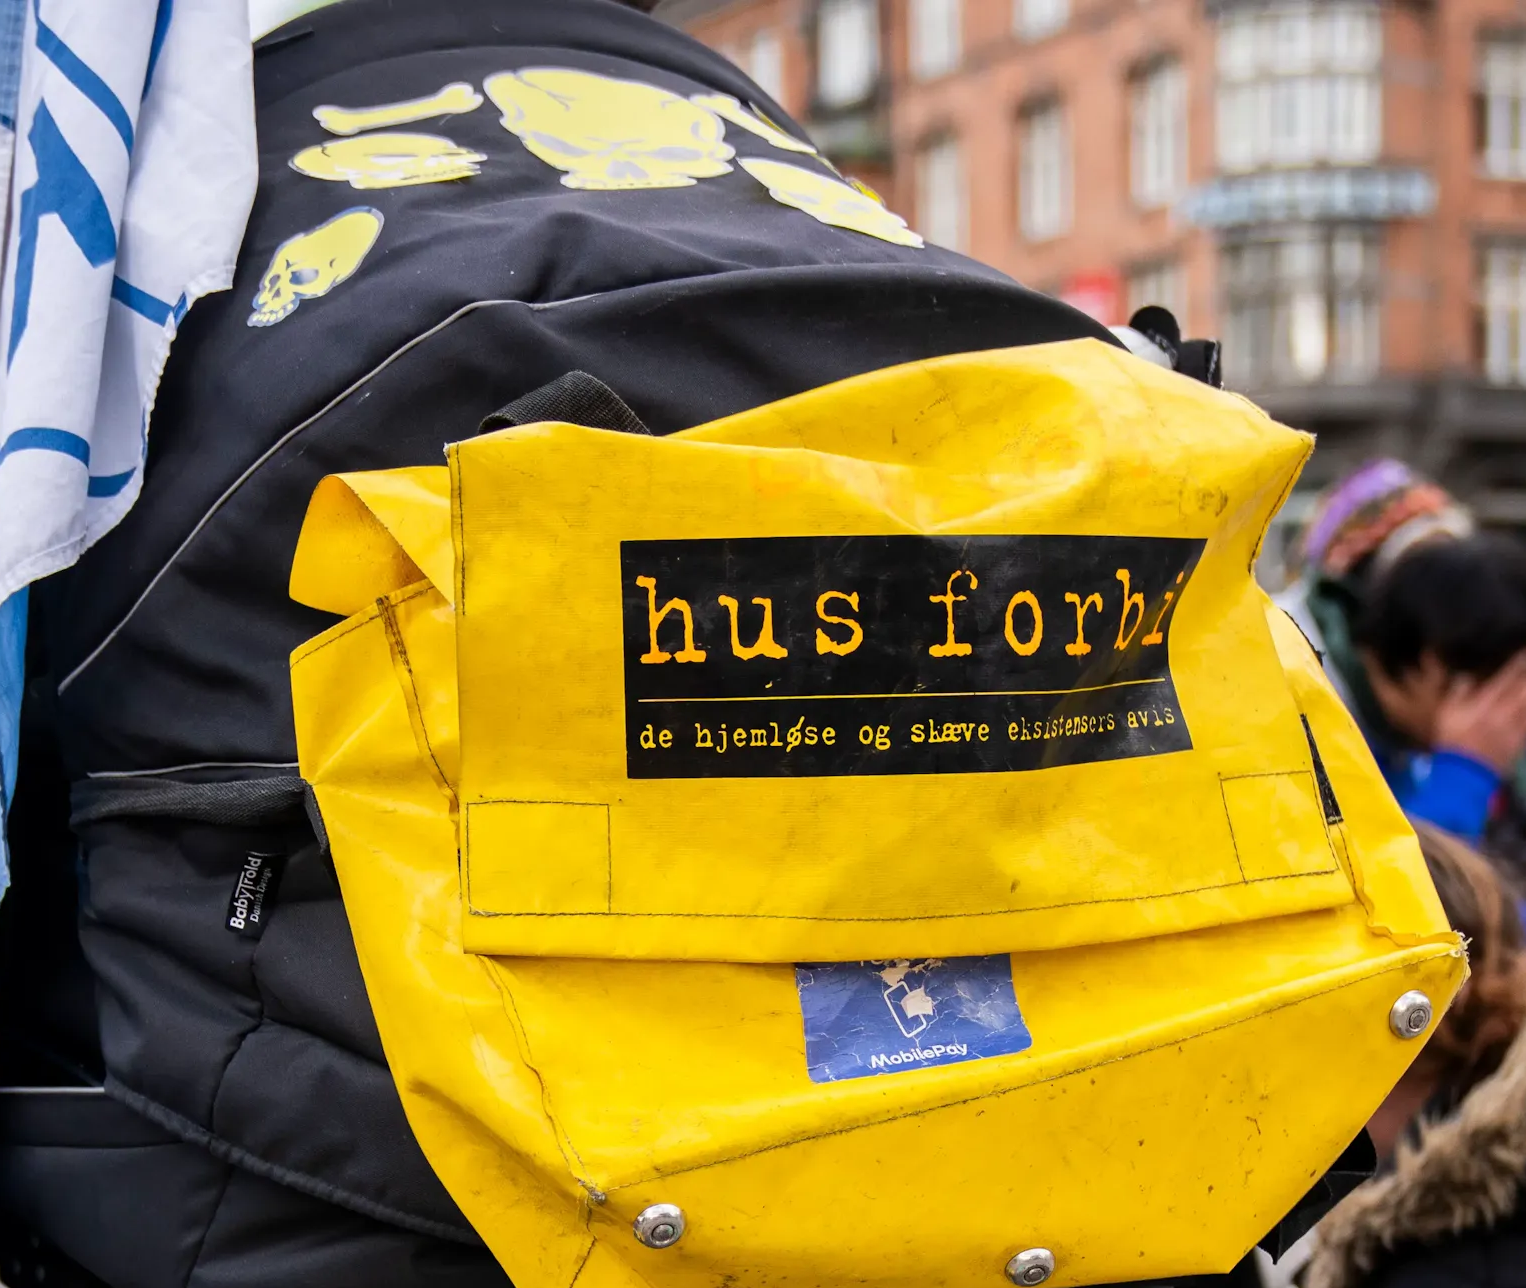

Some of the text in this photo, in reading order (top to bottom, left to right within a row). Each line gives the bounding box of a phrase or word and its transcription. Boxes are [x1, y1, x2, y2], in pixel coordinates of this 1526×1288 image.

[635, 568, 1184, 664] hus forbi
[639, 724, 673, 749] de
[694, 715, 836, 753] hjemløse
[858, 724, 892, 750] og
[910, 719, 990, 743] skæve
[1126, 705, 1175, 728] avis
[230, 857, 262, 929] BabyTrold
[869, 1042, 969, 1070] MobilePay
